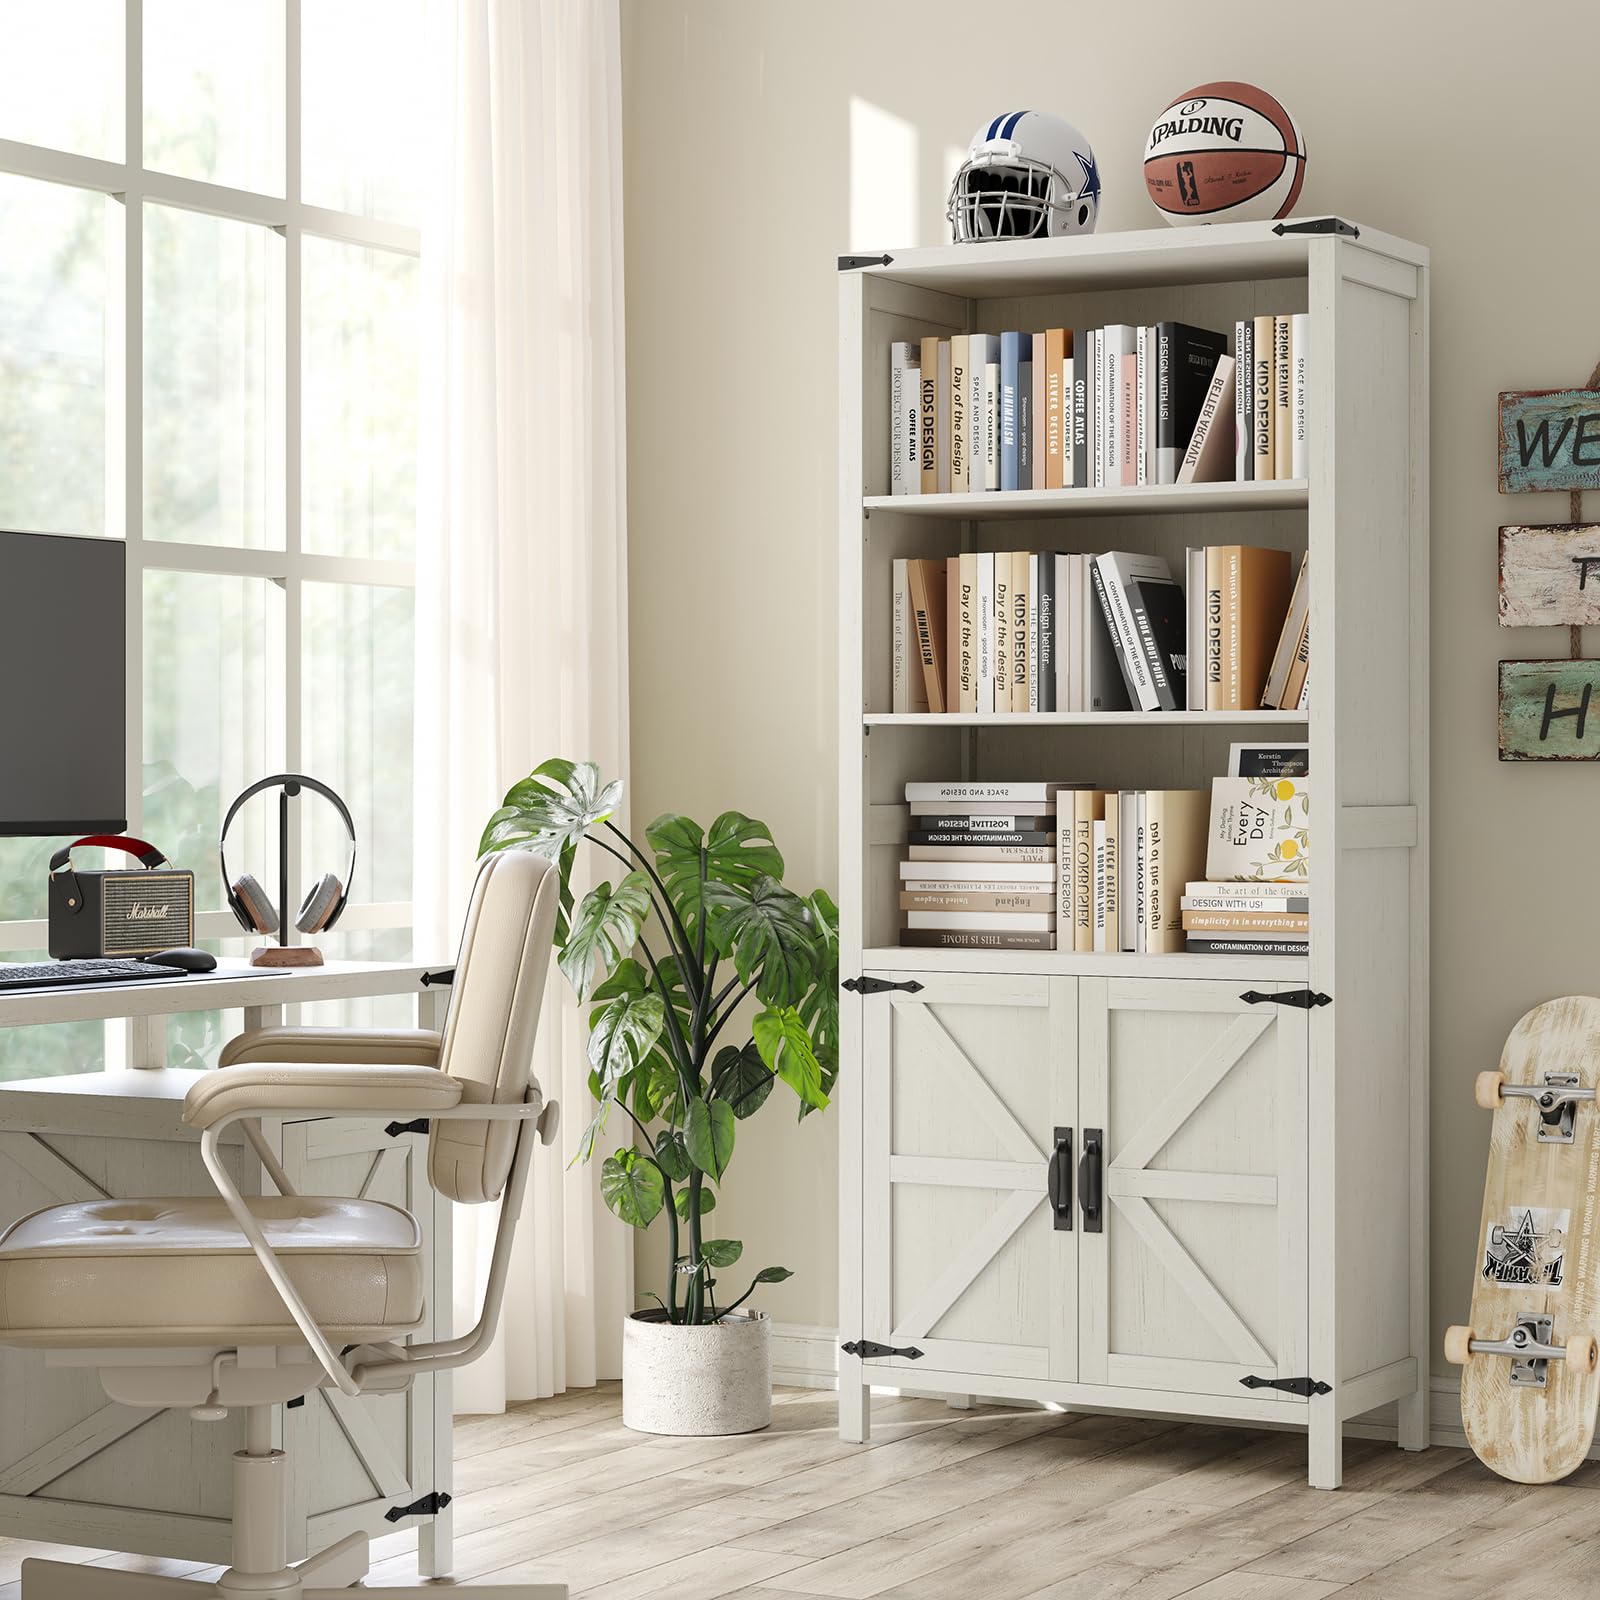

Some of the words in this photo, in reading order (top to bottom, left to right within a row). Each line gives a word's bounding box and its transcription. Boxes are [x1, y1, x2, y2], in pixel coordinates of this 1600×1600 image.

[1150, 117, 1244, 150] SPALDING
[953, 367, 963, 390] Day
[1049, 374, 1058, 410] SILVER
[1065, 387, 1070, 400] BE
[923, 380, 934, 413] KIDS
[954, 394, 963, 408] of
[988, 392, 992, 404] BE
[1075, 380, 1084, 414] COFFEE
[954, 410, 963, 430] the
[1004, 386, 1014, 445] MINIMALISM
[1075, 416, 1084, 445] ATLAS
[1109, 414, 1114, 424] OF
[923, 417, 934, 470] DESIGN
[1049, 416, 1058, 454] DESIGN
[953, 434, 963, 475] design
[961, 584, 970, 608] Day
[996, 584, 1006, 607] Day
[1014, 594, 1025, 627] KIDS
[1093, 568, 1103, 590] OPEN
[1100, 592, 1113, 621] DESIGN
[1109, 622, 1121, 648] NIGHT
[1109, 581, 1130, 636] CONTAMINATION
[962, 611, 971, 625] of
[998, 610, 1007, 624] of
[1040, 594, 1052, 629] design
[916, 610, 933, 665] MINIMALISM
[962, 628, 971, 647] the
[998, 627, 1007, 646] the
[1042, 632, 1052, 671] better...
[1127, 637, 1134, 646] OF
[1014, 631, 1025, 684] DESIGN
[1130, 646, 1139, 660] THE
[1137, 616, 1150, 635] BOOK
[1144, 637, 1158, 659] ABOUT
[1151, 662, 1166, 688] POINTS
[961, 651, 971, 691] design
[996, 650, 1007, 690] design
[1134, 661, 1146, 686] DESIGN
[1233, 800, 1254, 845] Every
[1250, 808, 1269, 839] Day
[126, 902, 168, 919] Marshall
[995, 896, 1031, 907] England
[1192, 899, 1223, 907] DESIGN
[1225, 900, 1246, 908] WITH
[1249, 900, 1262, 908] US!
[940, 935, 968, 944] HOME
[970, 936, 978, 944] IS
[980, 936, 1002, 944] THIS
[1210, 943, 1263, 951] CONTAMINATION
[1588, 1152, 1599, 1192] WARNING
[1583, 1194, 1595, 1236] WARNING
[1578, 1238, 1590, 1278] WARNING
